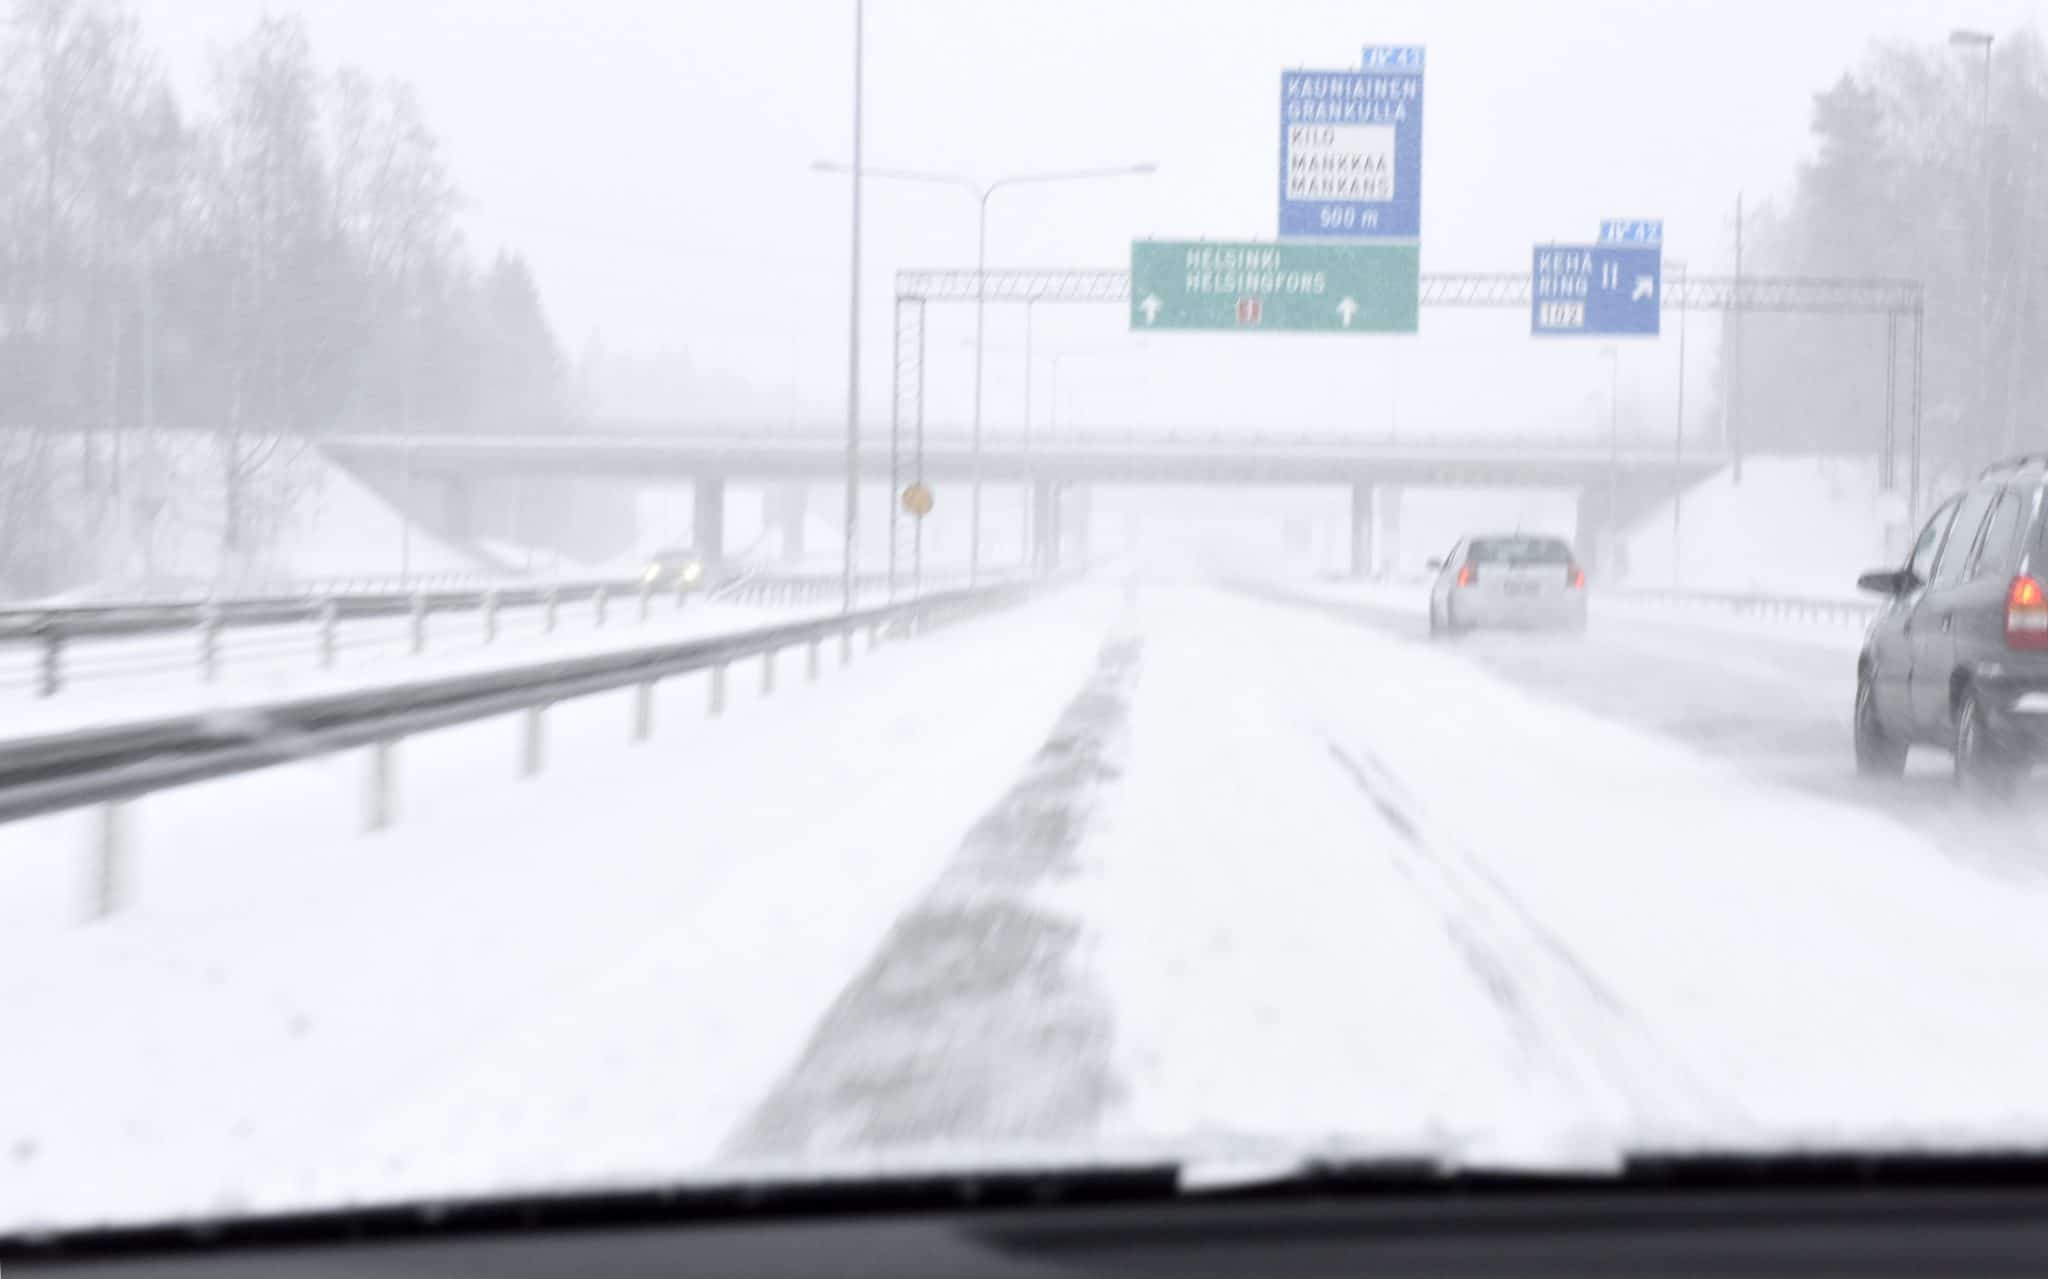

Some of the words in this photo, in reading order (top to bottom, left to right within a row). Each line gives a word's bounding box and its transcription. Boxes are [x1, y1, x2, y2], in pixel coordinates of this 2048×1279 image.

[1287, 78, 1417, 99] KAUNIAINEN
[1287, 101, 1406, 121] GRANKULLA
[1291, 127, 1335, 145] KILO
[1291, 152, 1385, 172] MANKKAA
[1291, 175, 1390, 194] MANKANS
[1320, 207, 1355, 228] 500
[1361, 209, 1378, 228] m
[1185, 248, 1281, 270] HELSINKI
[1185, 271, 1326, 293] HELSINGFORS
[1539, 275, 1588, 297] RING
[1602, 262, 1619, 290] II
[1545, 302, 1580, 323] 102
